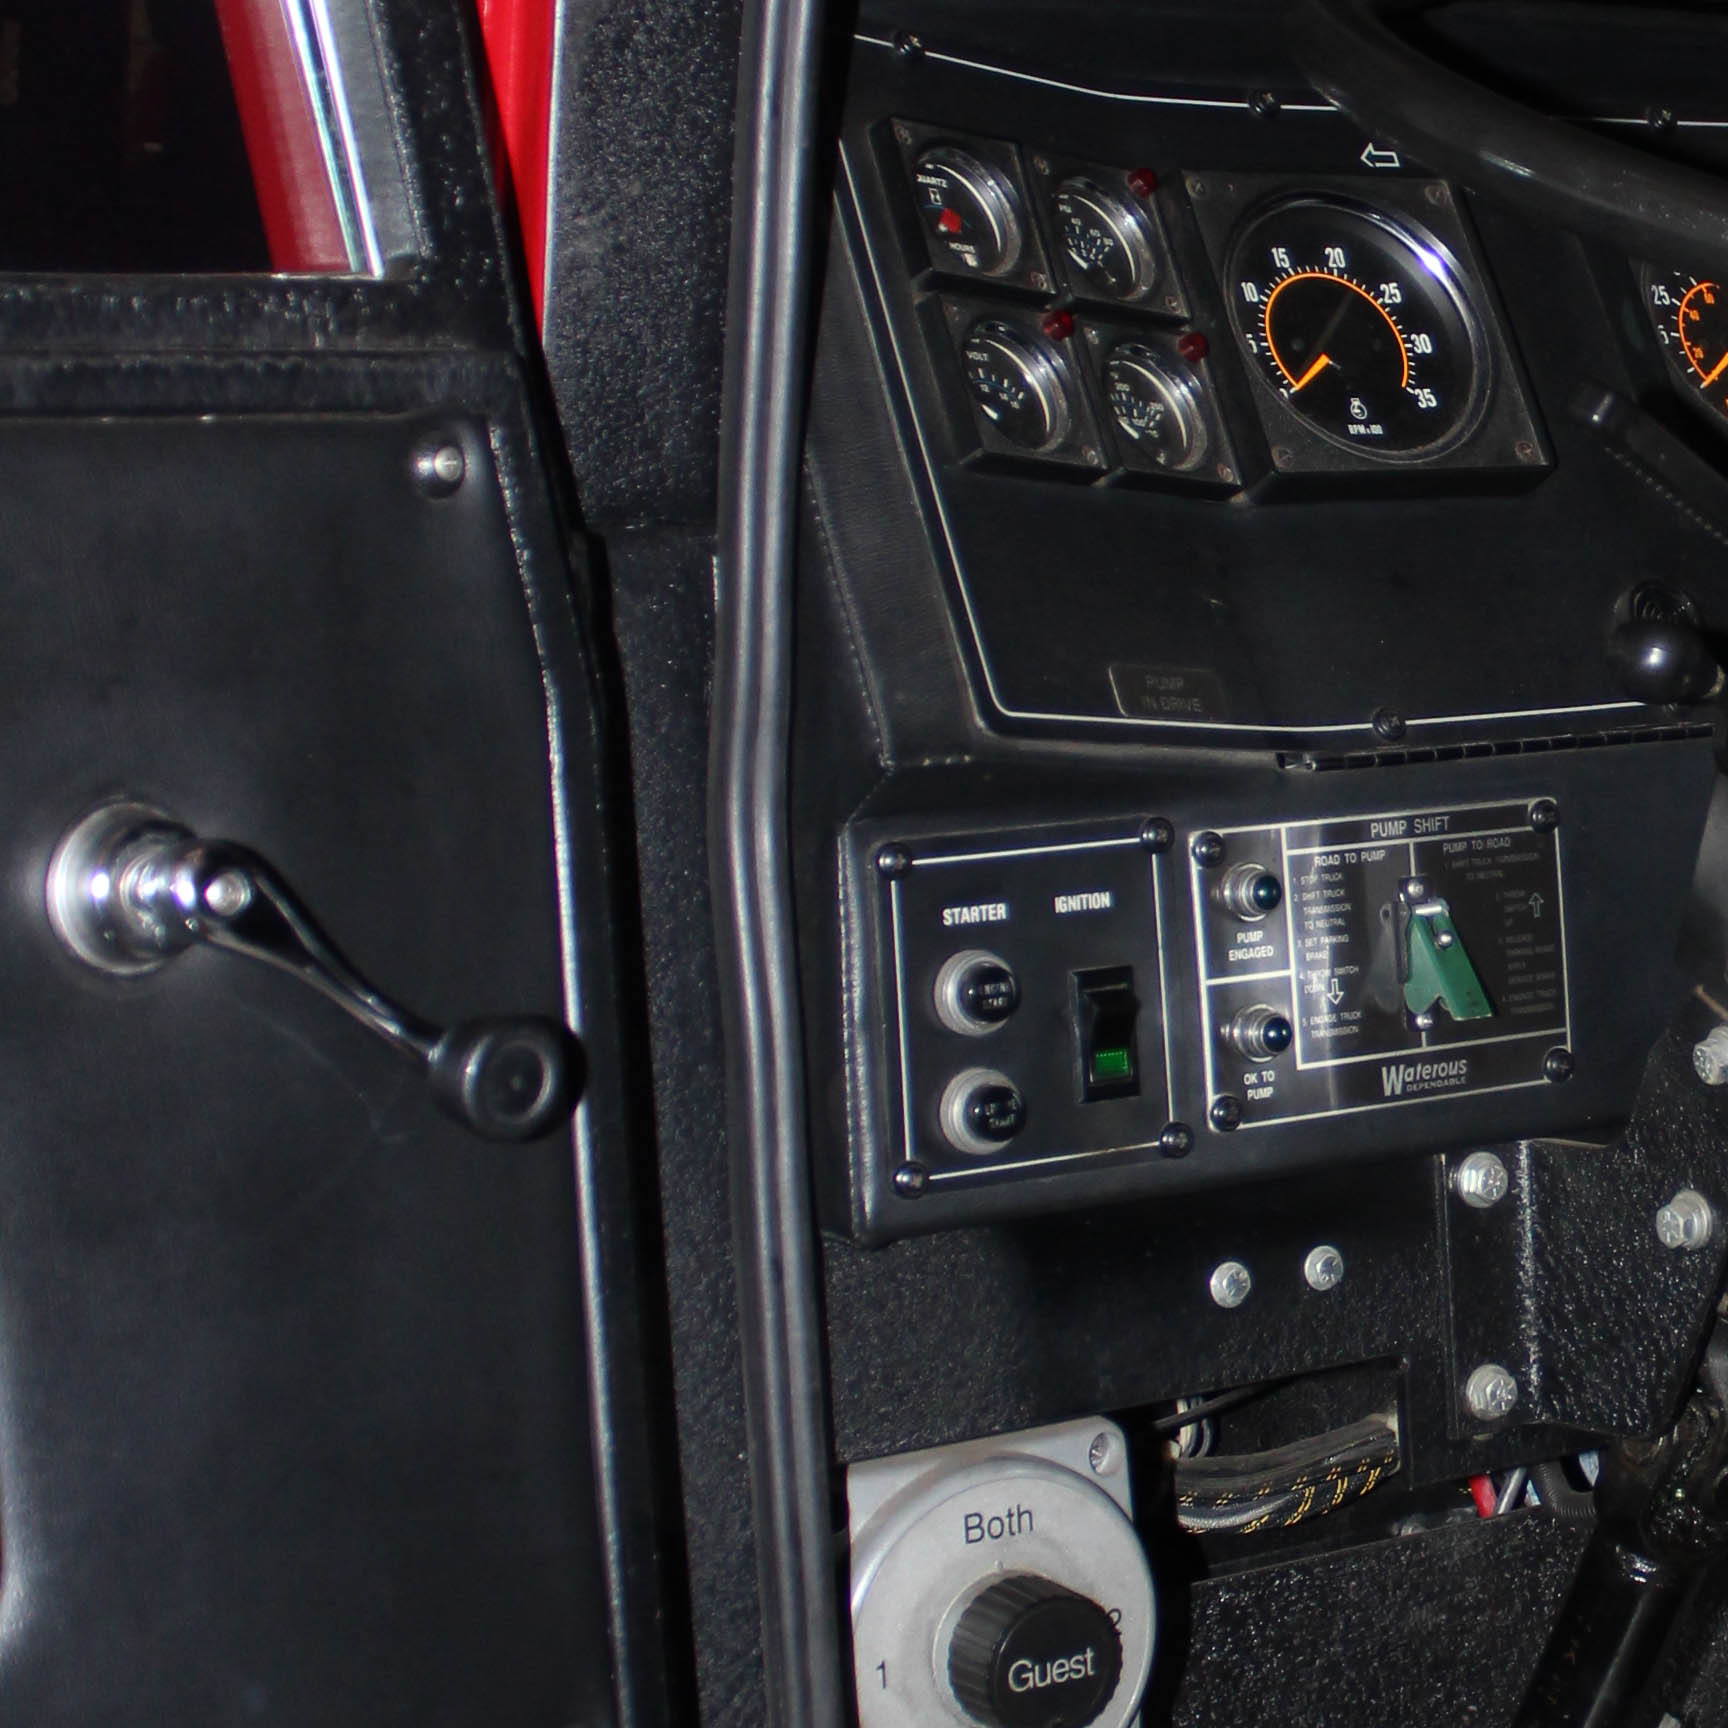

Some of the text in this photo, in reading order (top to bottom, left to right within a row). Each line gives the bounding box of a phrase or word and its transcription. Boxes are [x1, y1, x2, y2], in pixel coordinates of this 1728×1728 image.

[1271, 247, 1290, 269] 15
[1325, 247, 1346, 268] 20
[1241, 282, 1258, 303] 10
[1380, 282, 1402, 304] 25
[1651, 285, 1670, 305] 25
[1411, 334, 1433, 354] 30
[966, 350, 989, 362] VOLT
[1414, 388, 1437, 408] 35
[1370, 816, 1450, 839] PUMP SHIFT
[1443, 837, 1511, 854] PUMP TO ROAD
[1314, 850, 1386, 867] ROAD TO PUMP
[1054, 891, 1111, 914] IGNITION
[942, 902, 1008, 926] STARTER
[1236, 930, 1264, 944] PUMP
[1228, 946, 1274, 962] ENGAGED
[1243, 1070, 1275, 1085] OK TO
[1381, 1059, 1467, 1097] Waterous
[1406, 1076, 1467, 1093] DEPENDABLE
[1247, 1087, 1274, 1102] PUMP
[964, 1504, 1034, 1544] Both
[875, 1660, 887, 1689] 1
[1008, 1647, 1095, 1693] Guest
